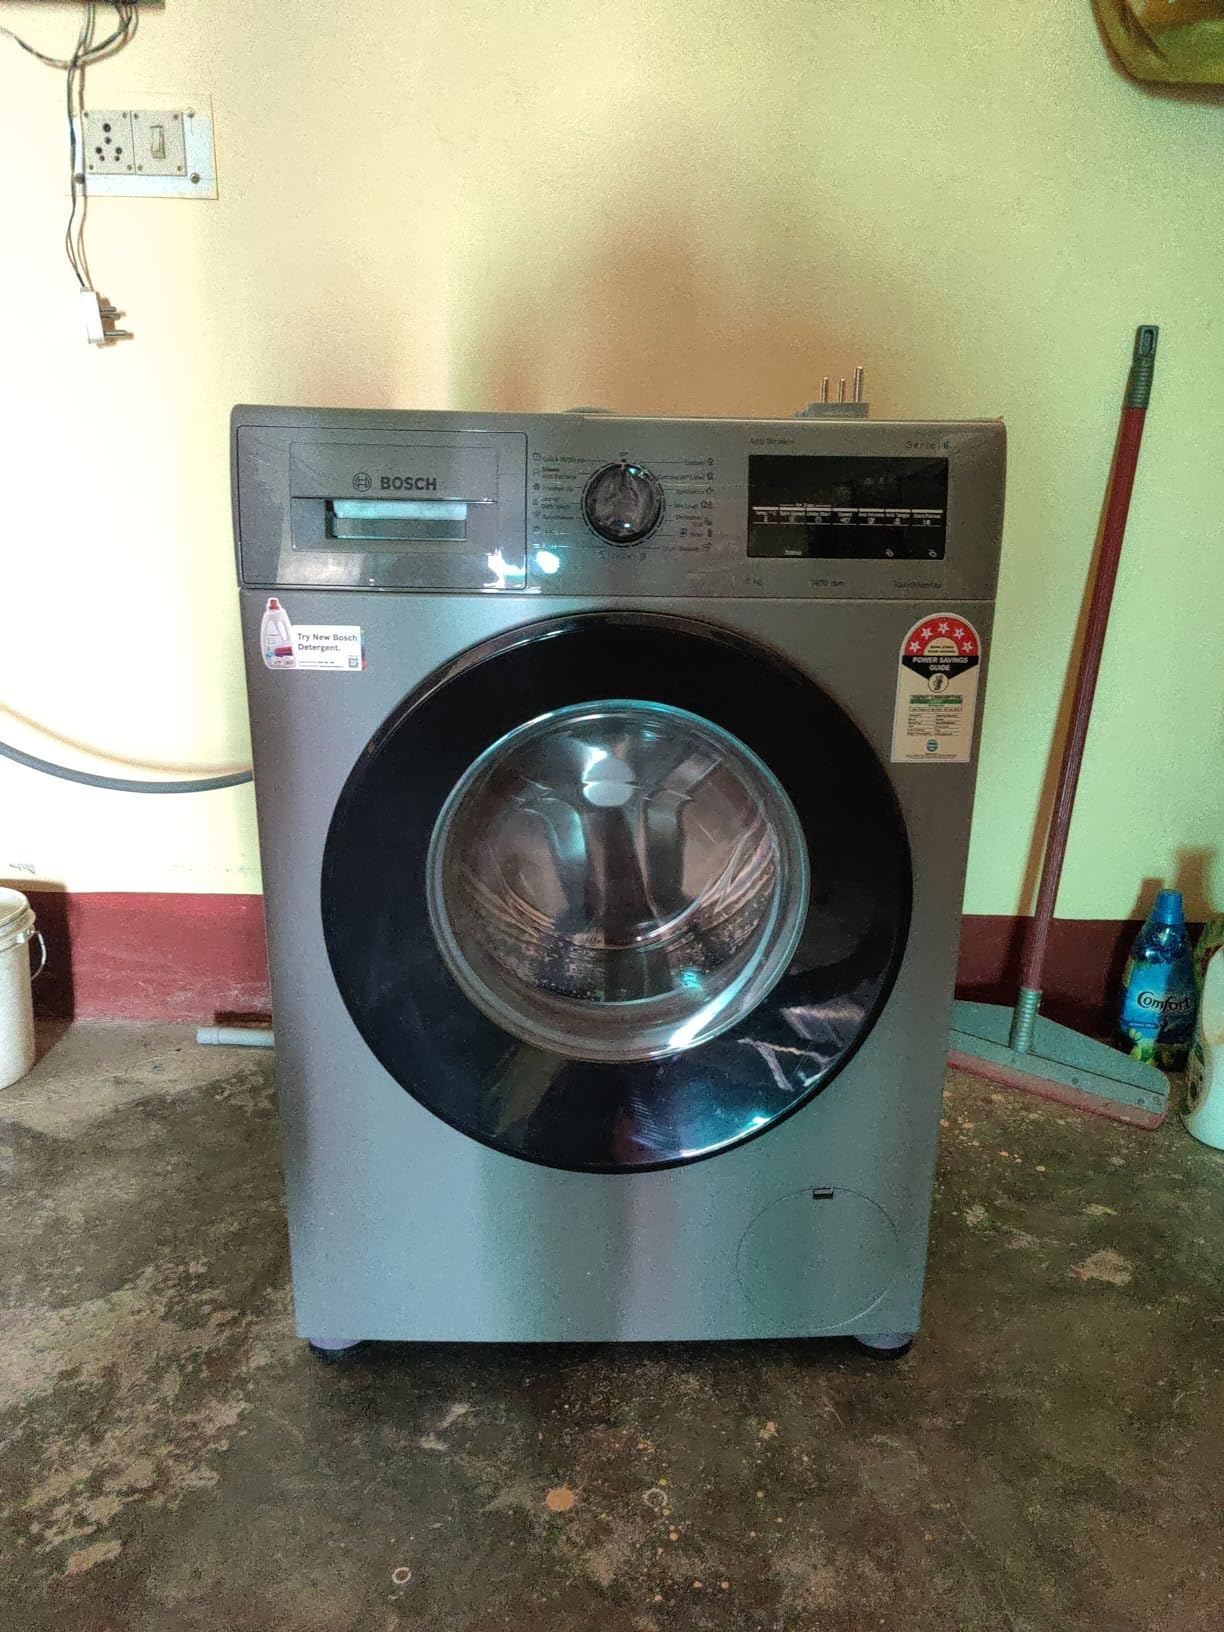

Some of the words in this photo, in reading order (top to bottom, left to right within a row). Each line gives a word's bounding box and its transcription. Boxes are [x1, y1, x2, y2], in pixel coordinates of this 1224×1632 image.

[380, 476, 437, 491] BOSCH
[297, 633, 310, 642] Try
[312, 633, 330, 641] New
[333, 634, 358, 642] Bosch
[298, 643, 341, 652] Detergent.
[912, 656, 938, 664] POWER
[939, 656, 969, 664] SAVINGS
[1136, 991, 1192, 1015] Comfort
